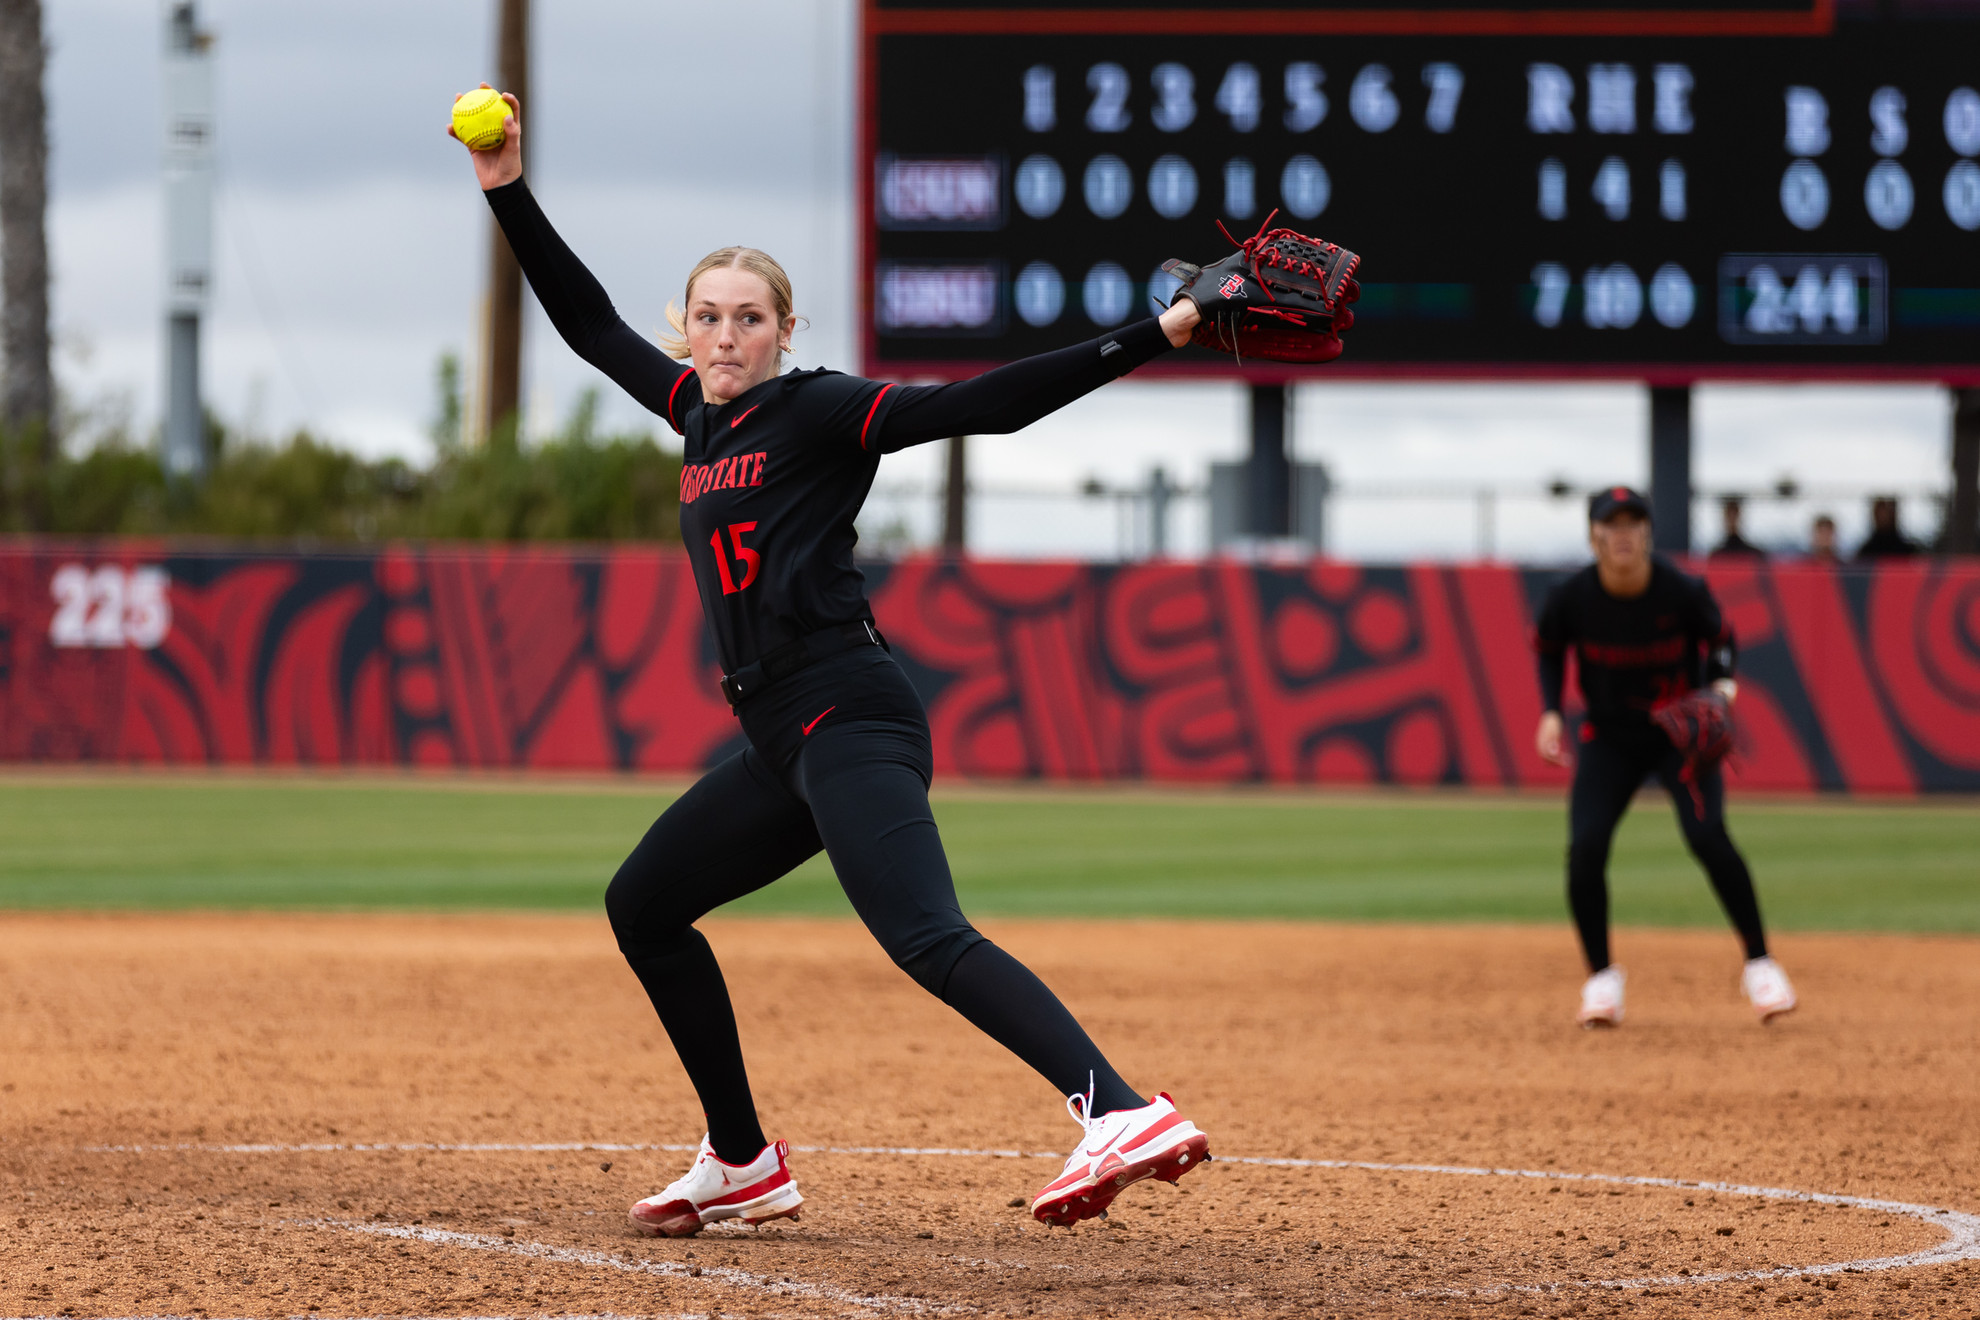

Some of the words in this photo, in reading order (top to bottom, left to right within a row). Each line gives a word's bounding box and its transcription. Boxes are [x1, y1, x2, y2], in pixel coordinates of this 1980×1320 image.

[1023, 64, 1056, 132] 1
[1086, 63, 1129, 132] 2
[1152, 63, 1196, 132] 3
[1216, 62, 1261, 132] 4
[1284, 62, 1328, 132] 5
[1349, 63, 1399, 132] 6
[1422, 62, 1464, 132] 7
[1527, 63, 1574, 133] R
[1587, 63, 1637, 133] H
[1653, 63, 1694, 133] E
[1785, 86, 1830, 156] B
[1869, 86, 1909, 156] S
[1015, 156, 1065, 218] 0
[1083, 156, 1132, 218] 0
[1148, 156, 1198, 218] 0
[1224, 158, 1256, 219] 1
[1281, 156, 1330, 218] 0
[1538, 158, 1567, 221] 1
[1592, 156, 1631, 221] 4
[1659, 159, 1687, 221] 1
[1780, 159, 1830, 230] 0
[1864, 159, 1915, 230] 0
[1015, 263, 1065, 326] 0
[1083, 263, 1133, 326] 0
[1531, 263, 1571, 328] 7
[1649, 263, 1695, 328] 0
[703, 451, 767, 494] STATE
[709, 521, 761, 596] 15
[51, 563, 172, 649] 225
